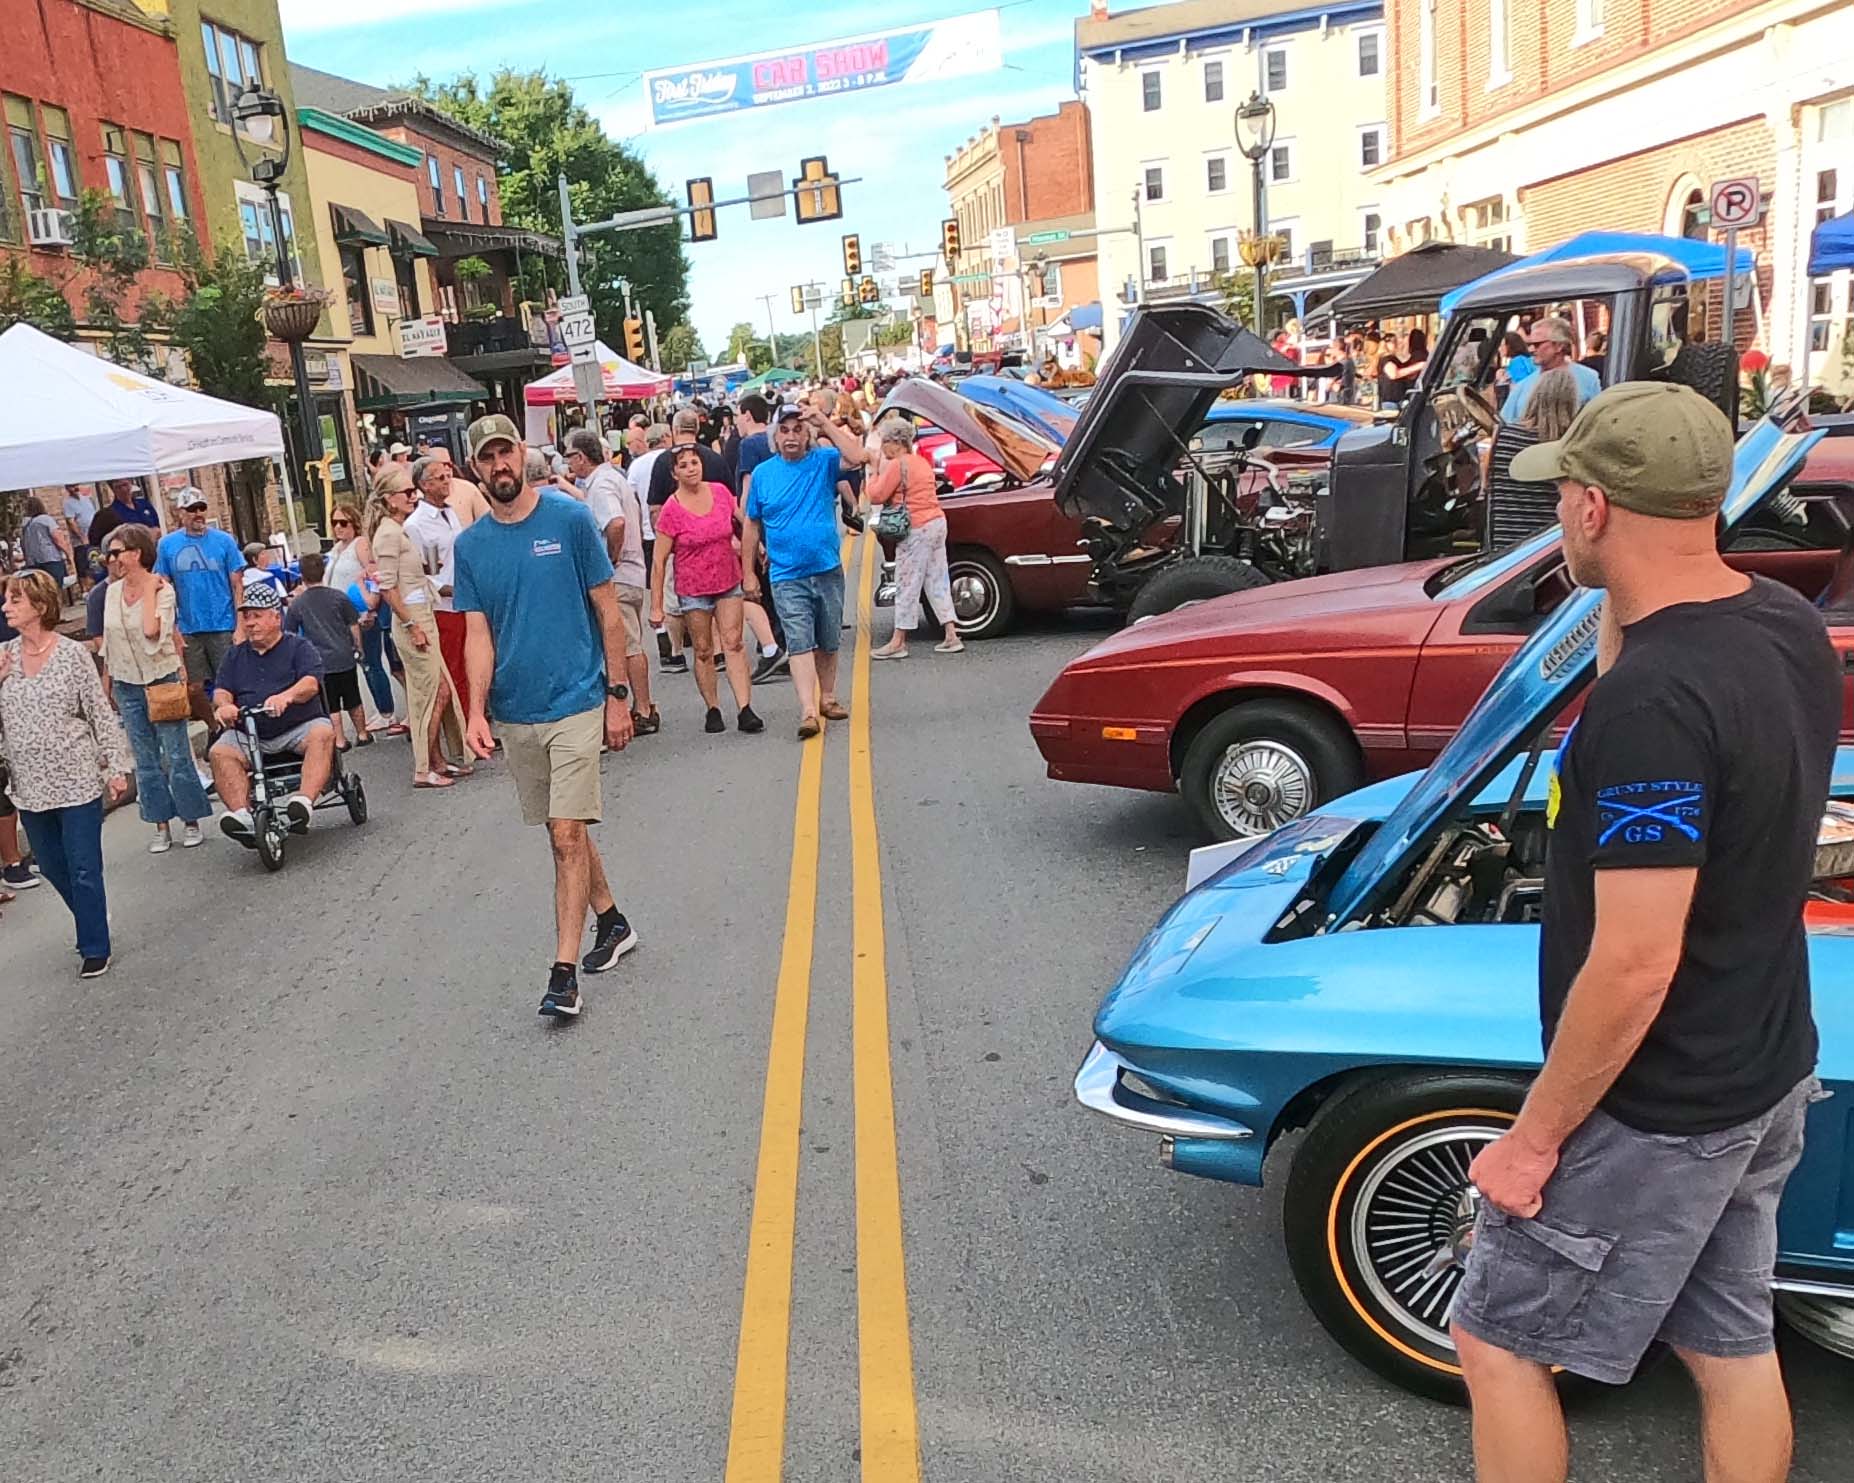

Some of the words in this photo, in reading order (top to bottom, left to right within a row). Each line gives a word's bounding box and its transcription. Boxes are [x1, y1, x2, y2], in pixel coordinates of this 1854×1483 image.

[754, 59, 806, 89] CAR
[816, 42, 887, 78] SHOW
[562, 300, 586, 312] SOUTH
[565, 319, 593, 338] 472
[1650, 781, 1702, 792] STYLE
[1625, 824, 1662, 842] GS
